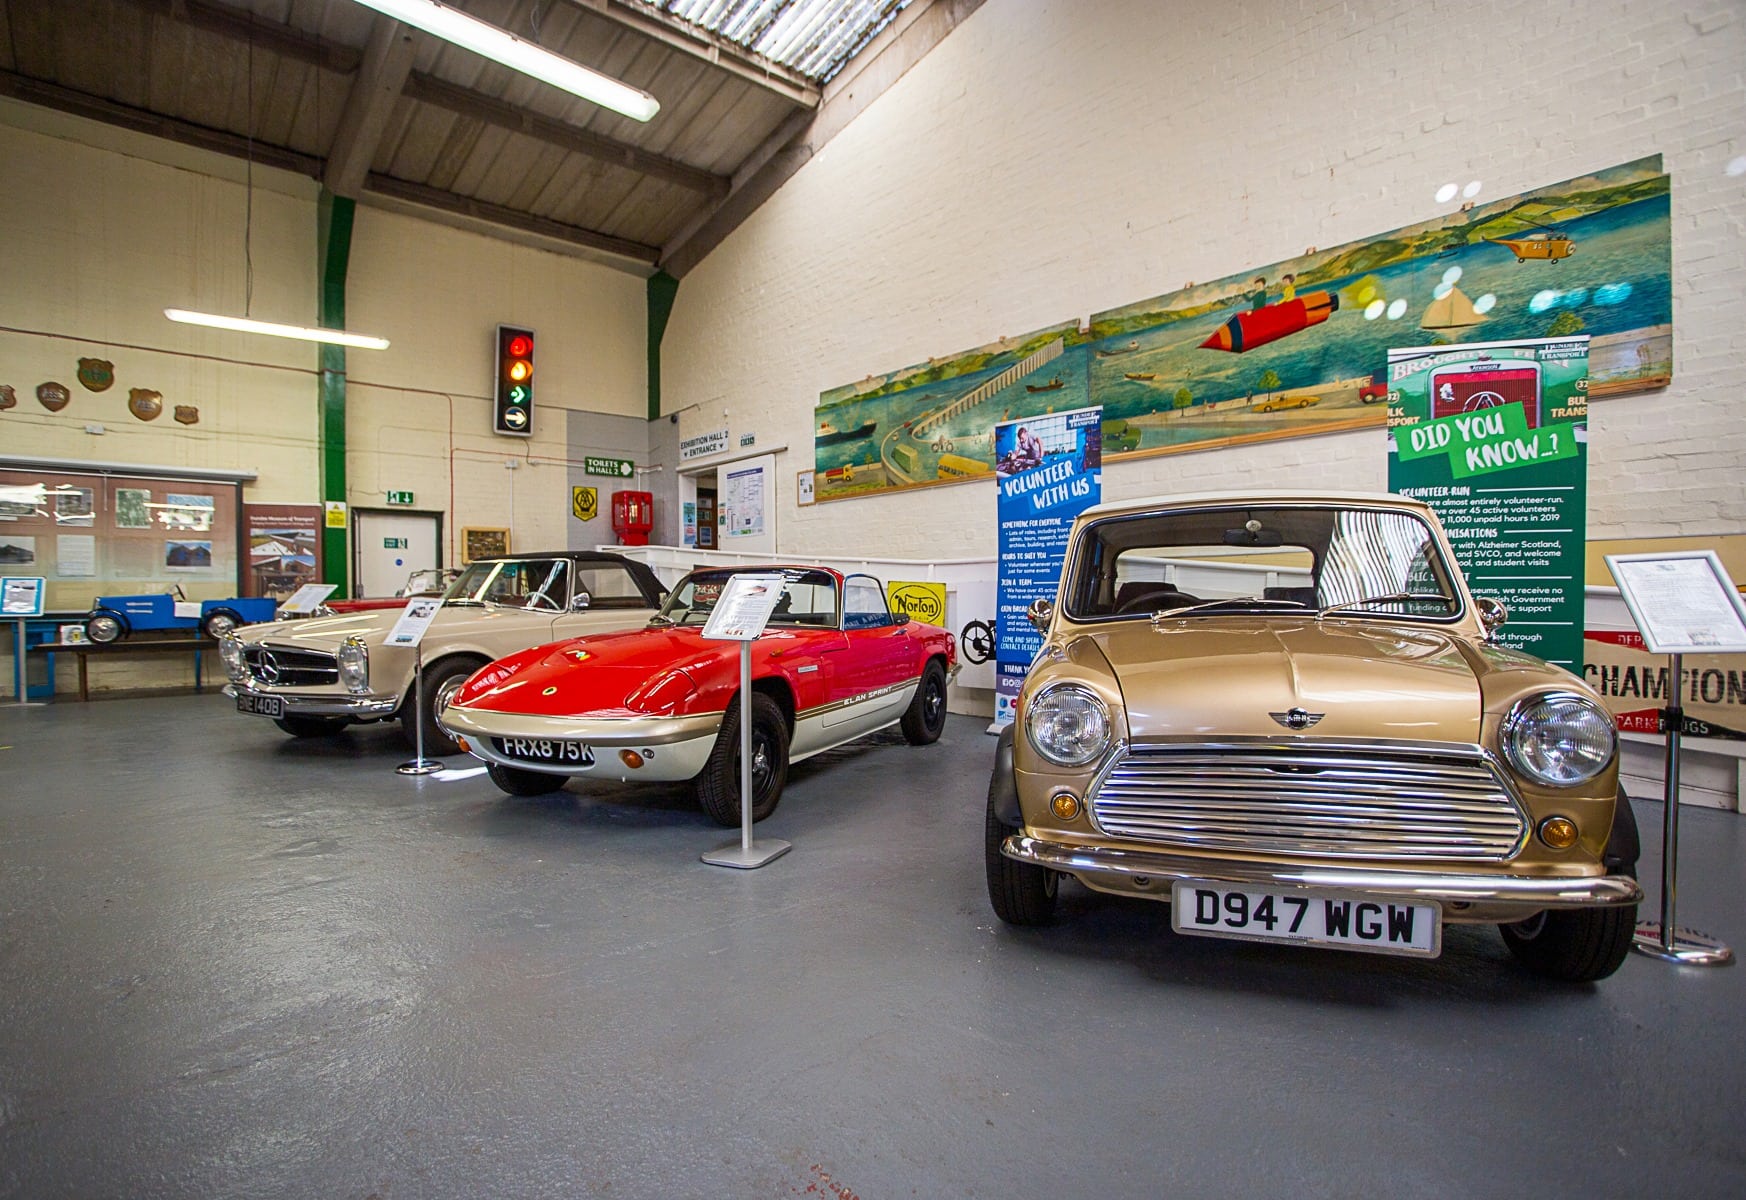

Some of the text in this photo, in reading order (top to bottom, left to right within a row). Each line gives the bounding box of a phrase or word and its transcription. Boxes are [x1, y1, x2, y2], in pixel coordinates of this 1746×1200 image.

[1567, 396, 1588, 406] BUL
[1550, 407, 1588, 418] TRANS
[1410, 412, 1505, 452] DID YOU
[681, 436, 708, 450] EXHIBITION
[709, 432, 723, 442] HALL
[689, 443, 717, 457] ENTRANCE
[587, 459, 618, 468] TOILETS
[595, 467, 612, 475] HALL
[1005, 460, 1074, 497] VOLUNTEER
[1033, 477, 1090, 510] WITH US
[1442, 498, 1468, 506] almost
[1470, 497, 1501, 506] entirely
[1511, 505, 1556, 513] volunteers
[1447, 516, 1472, 524] 11,000
[1473, 515, 1502, 524] unpaid
[1504, 514, 1528, 522] hours
[1478, 541, 1519, 549] Alzheimer
[1521, 540, 1562, 548] Scotland,
[1036, 551, 1047, 559] YOU
[1527, 558, 1550, 566] visits
[1012, 578, 1016, 586] A
[1018, 578, 1032, 586] TEAM
[1511, 595, 1565, 603] Government
[894, 593, 938, 617] Norton
[1518, 605, 1552, 613] support
[1508, 633, 1542, 642] through
[1004, 664, 1024, 674] THANK
[844, 686, 893, 705] ELAN SPRINT
[1194, 888, 1415, 944] D947 WGW
